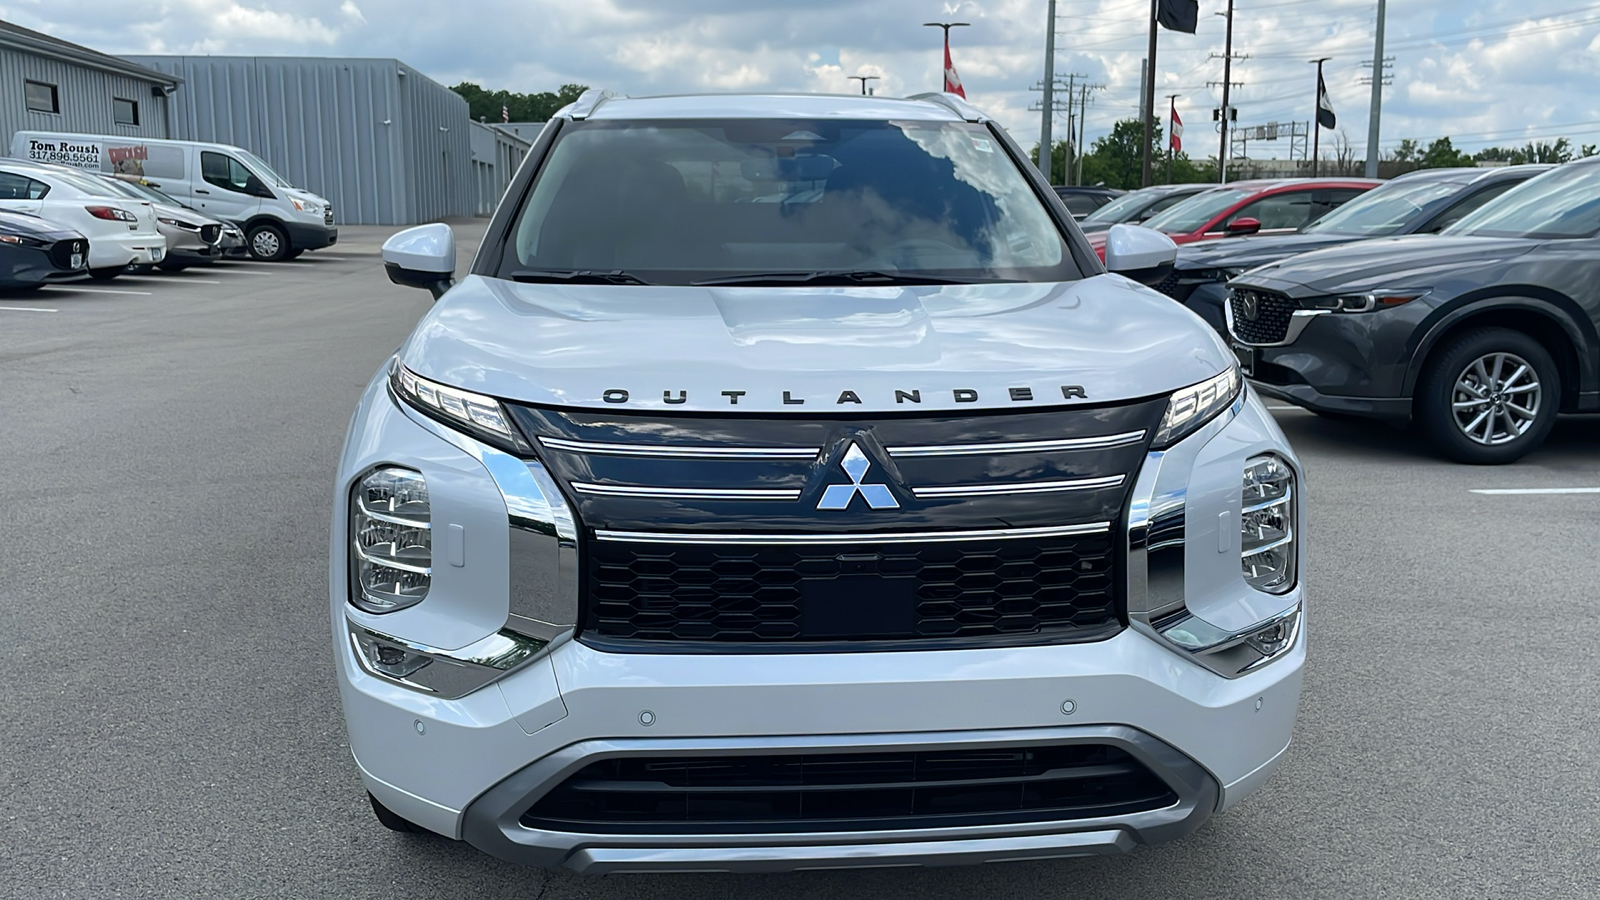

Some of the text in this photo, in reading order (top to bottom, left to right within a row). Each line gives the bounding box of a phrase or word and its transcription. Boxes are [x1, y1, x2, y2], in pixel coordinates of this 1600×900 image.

[30, 140, 99, 154] Tom Roush
[602, 385, 1088, 405] OUTLANDER
